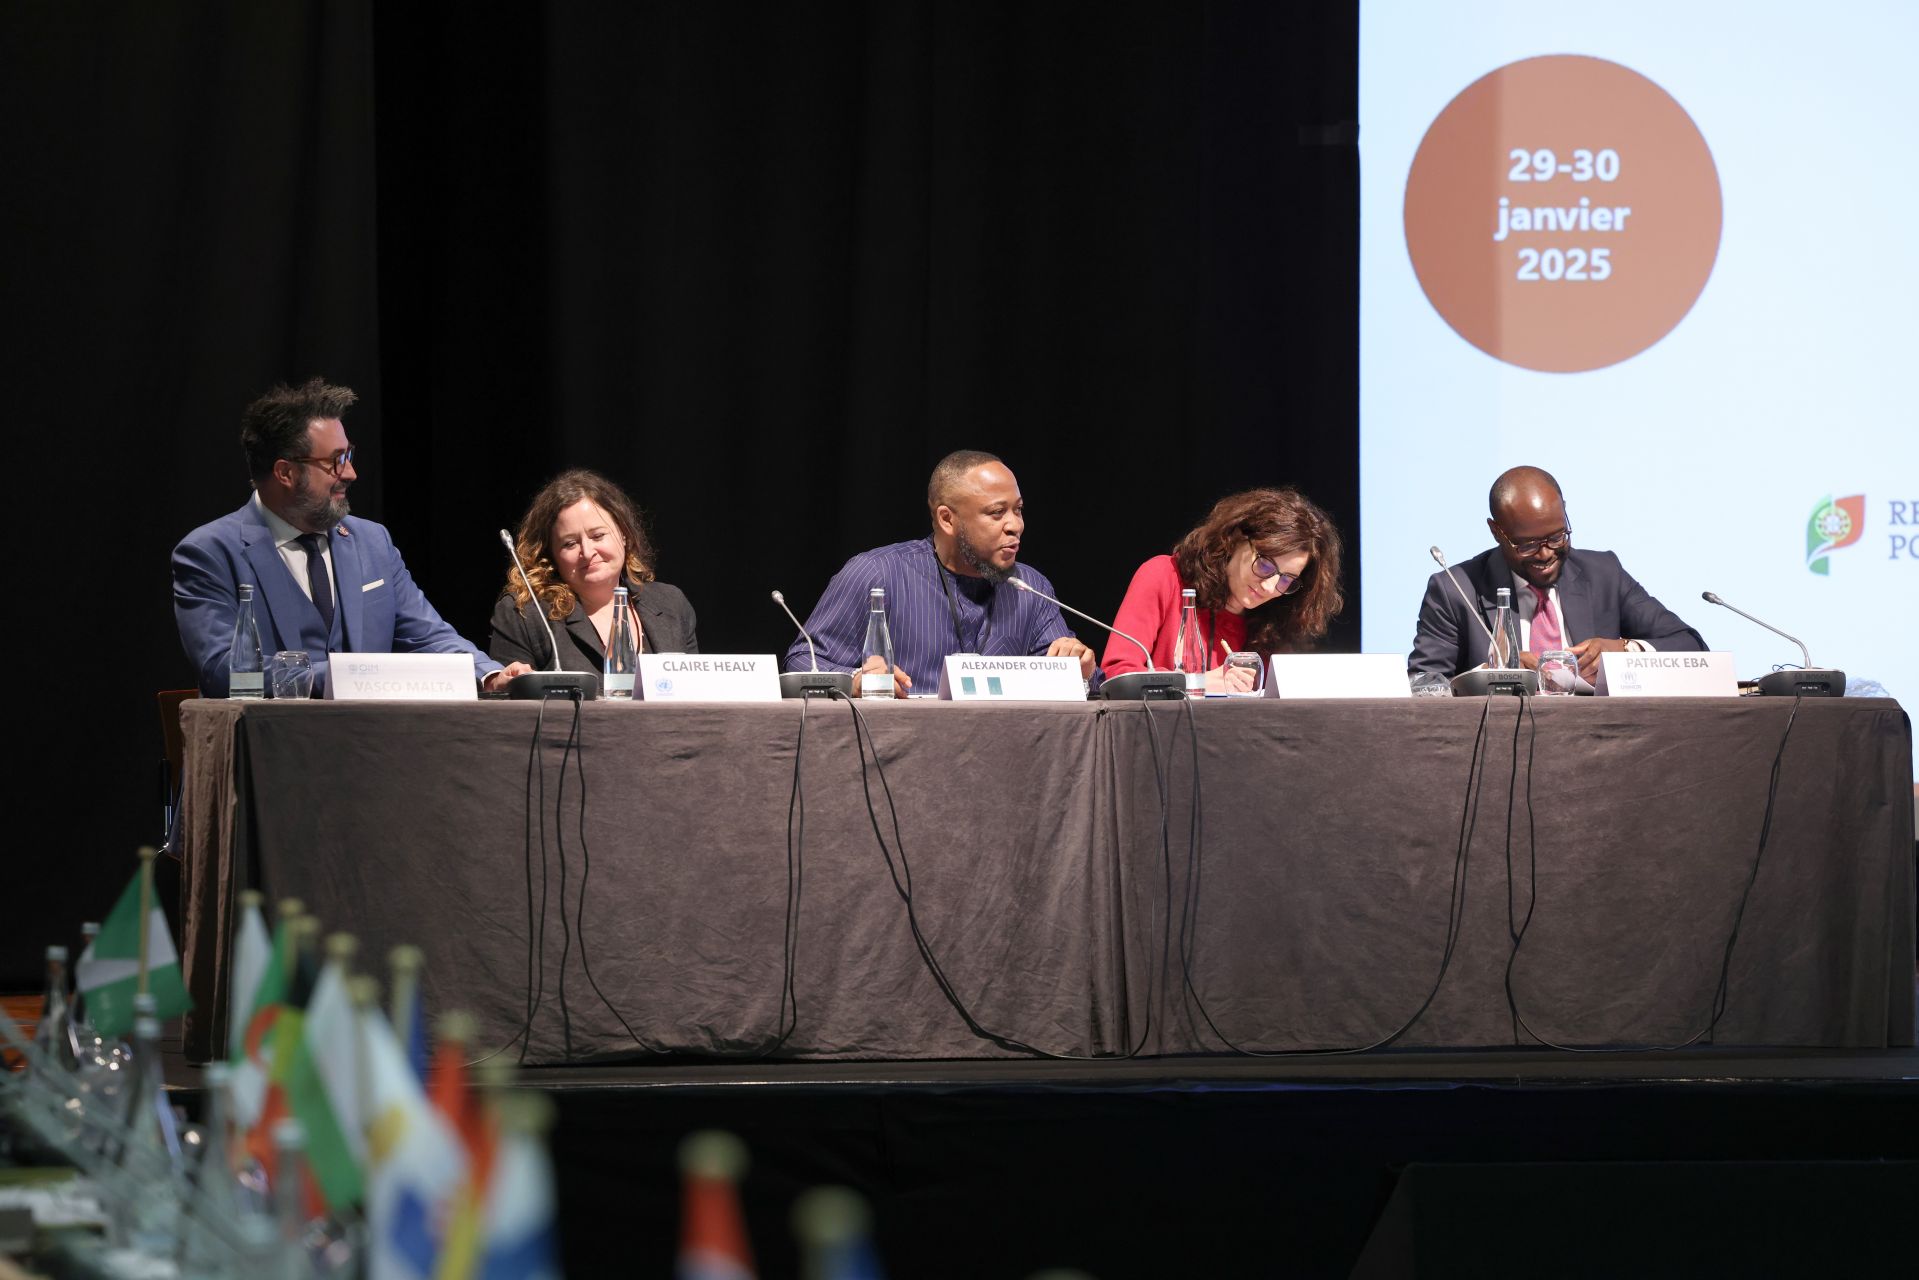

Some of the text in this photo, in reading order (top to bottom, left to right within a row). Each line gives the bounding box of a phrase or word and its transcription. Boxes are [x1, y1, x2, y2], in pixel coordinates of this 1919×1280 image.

[1508, 148, 1620, 182] 29-30
[1493, 196, 1632, 242] janvier
[1516, 248, 1612, 281] 2025
[662, 660, 756, 672] CLAIRE HEALY
[961, 661, 1068, 671] ALEXANDER OTURU
[1625, 657, 1709, 669] PATRICK EBA
[1498, 673, 1523, 681] BOSCH
[354, 681, 455, 693] VASCO MALTA
